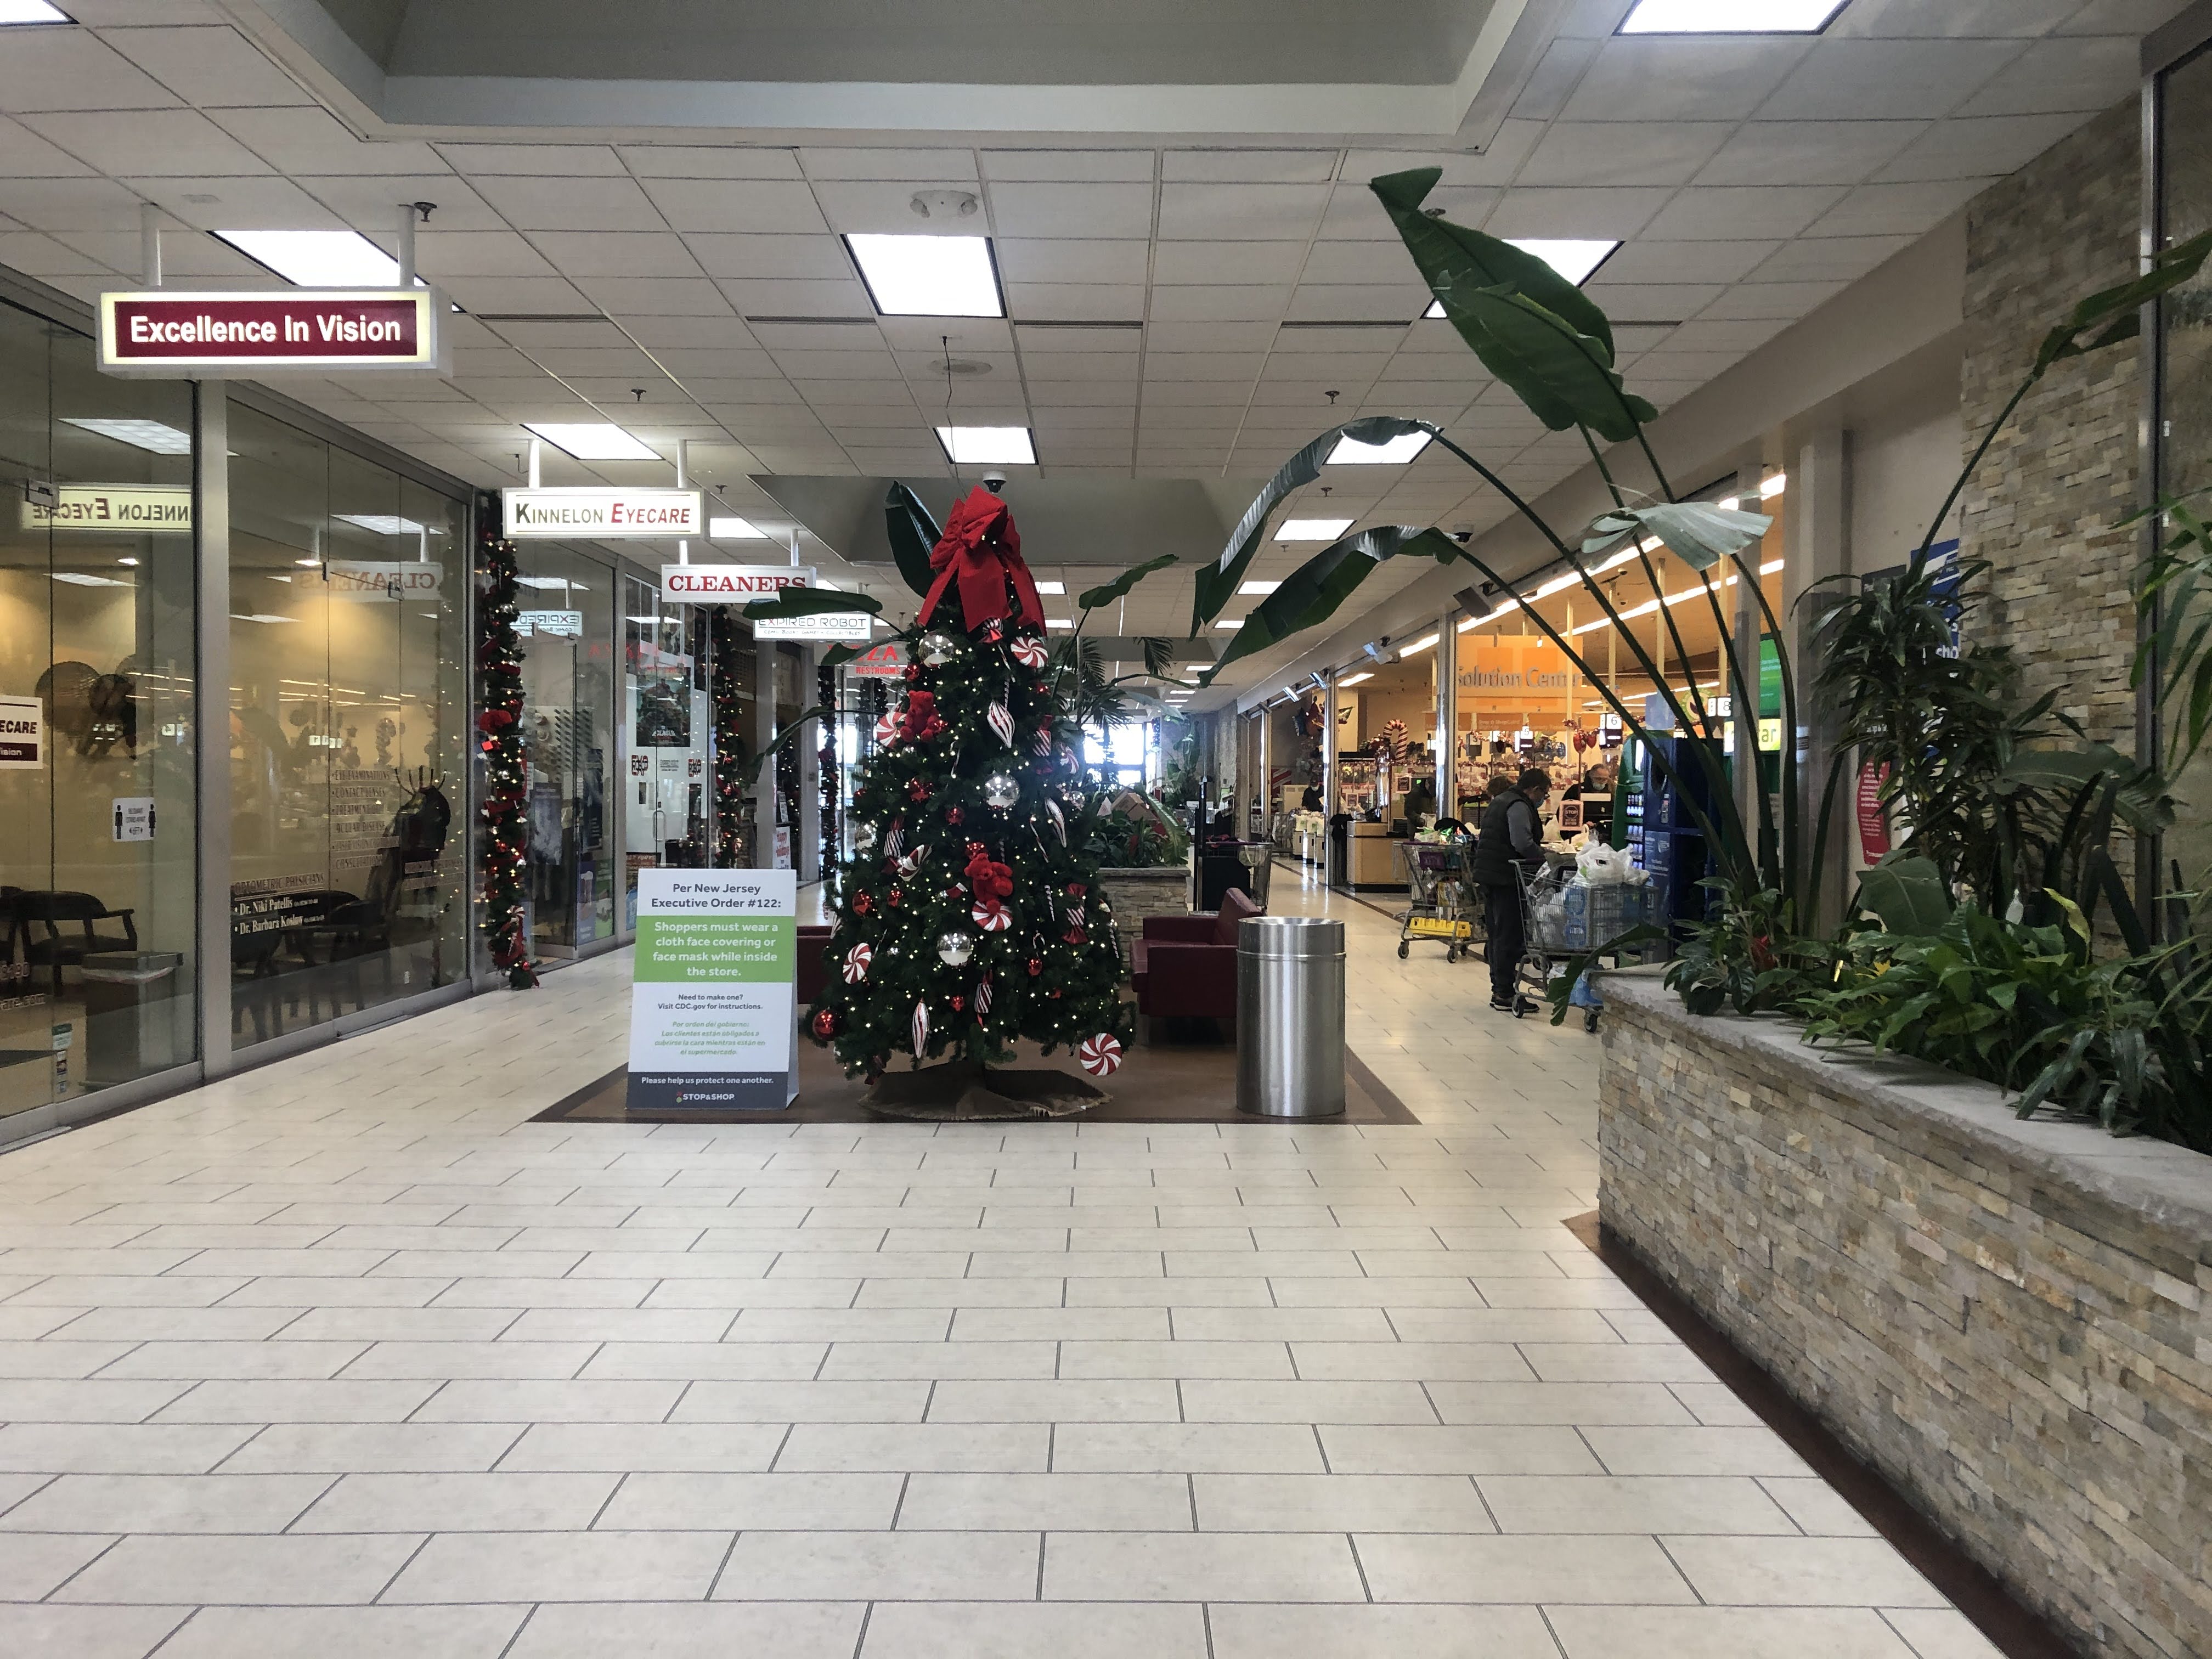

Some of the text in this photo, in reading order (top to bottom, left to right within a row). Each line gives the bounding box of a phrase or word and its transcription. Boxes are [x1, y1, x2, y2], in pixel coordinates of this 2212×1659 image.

[131, 314, 401, 342] Excellence In Vision
[516, 503, 691, 523] KINNELON EYECARE
[669, 575, 806, 592] CLEANERS
[759, 618, 866, 627] EXPIRED ROBOT
[856, 667, 900, 675] RESTROOMS
[1458, 665, 1581, 688] Solution Centr
[1723, 701, 1730, 711] 8
[1611, 716, 1617, 725] 6
[1524, 728, 1530, 736] 5
[673, 884, 761, 895] Per New Jersey
[240, 903, 251, 915] Dr.
[253, 900, 267, 912] Niki
[652, 898, 781, 908] Executive Order #122:
[240, 922, 251, 935] Dr.
[252, 918, 279, 932] Barbara
[654, 922, 708, 933] Shoppers
[710, 922, 739, 932] must
[656, 937, 684, 946] cloth
[687, 937, 710, 946] face
[713, 938, 761, 949] covering
[653, 952, 777, 961] face mask while inside
[687, 967, 741, 976] the store.
[667, 1077, 684, 1085] help
[696, 1077, 725, 1085] protect
